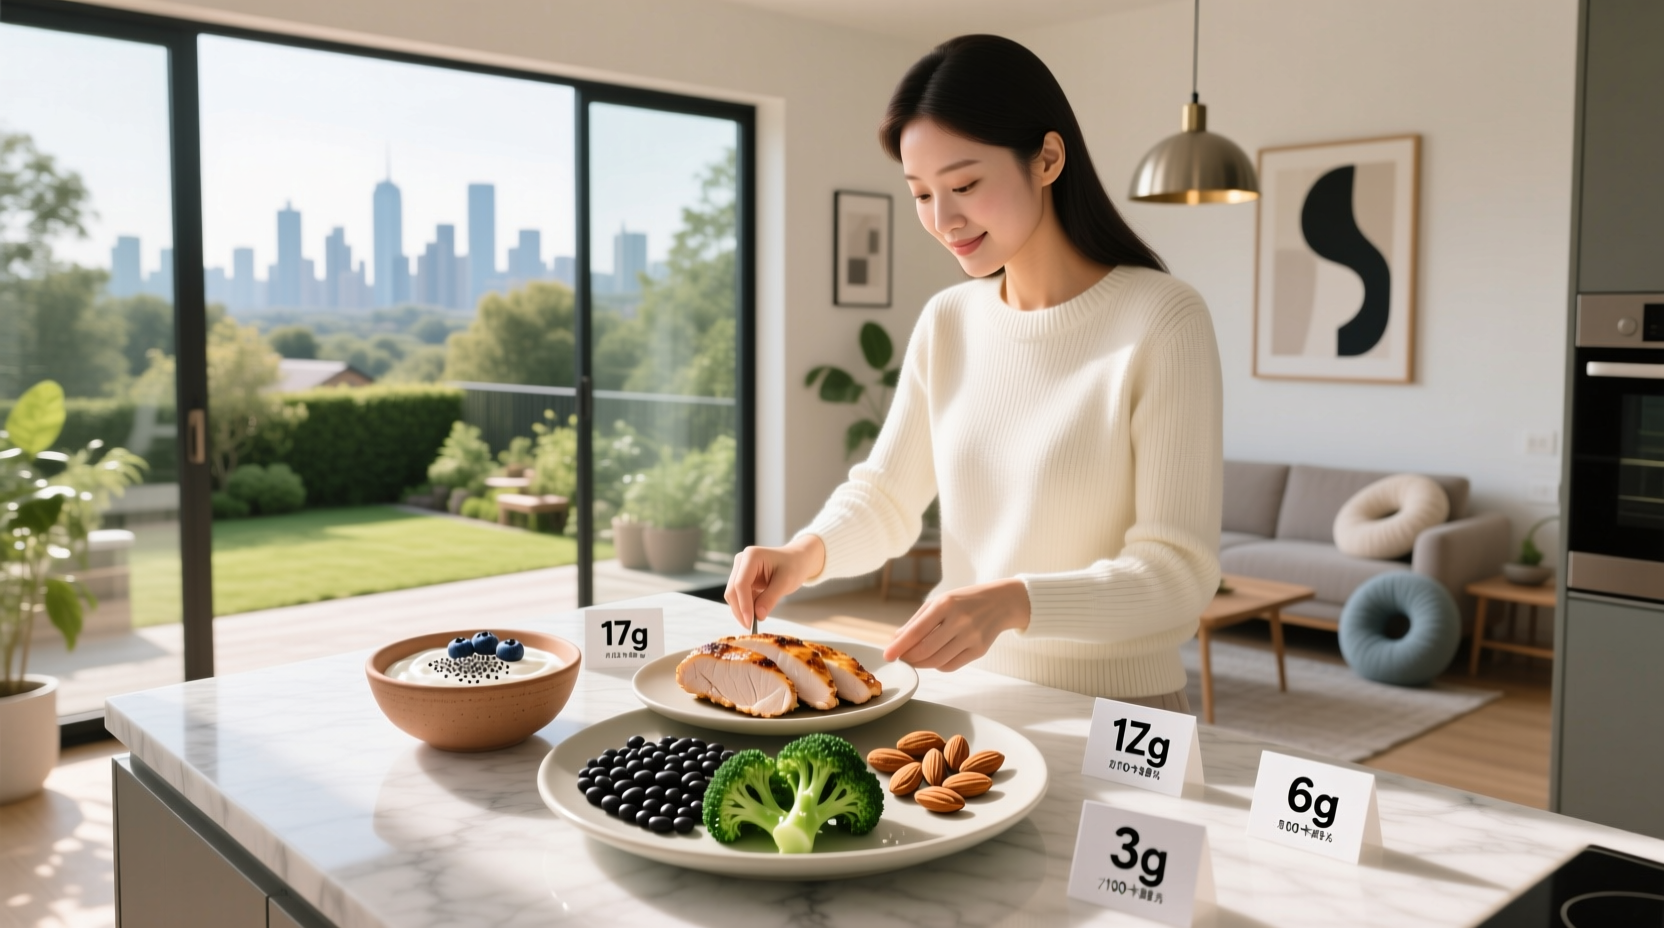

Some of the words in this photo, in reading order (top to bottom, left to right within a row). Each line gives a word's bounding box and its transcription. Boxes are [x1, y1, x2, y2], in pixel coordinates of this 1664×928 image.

[601, 620, 648, 651] 17g
[1288, 776, 1339, 828] 6g
[1110, 826, 1167, 888] 3g
